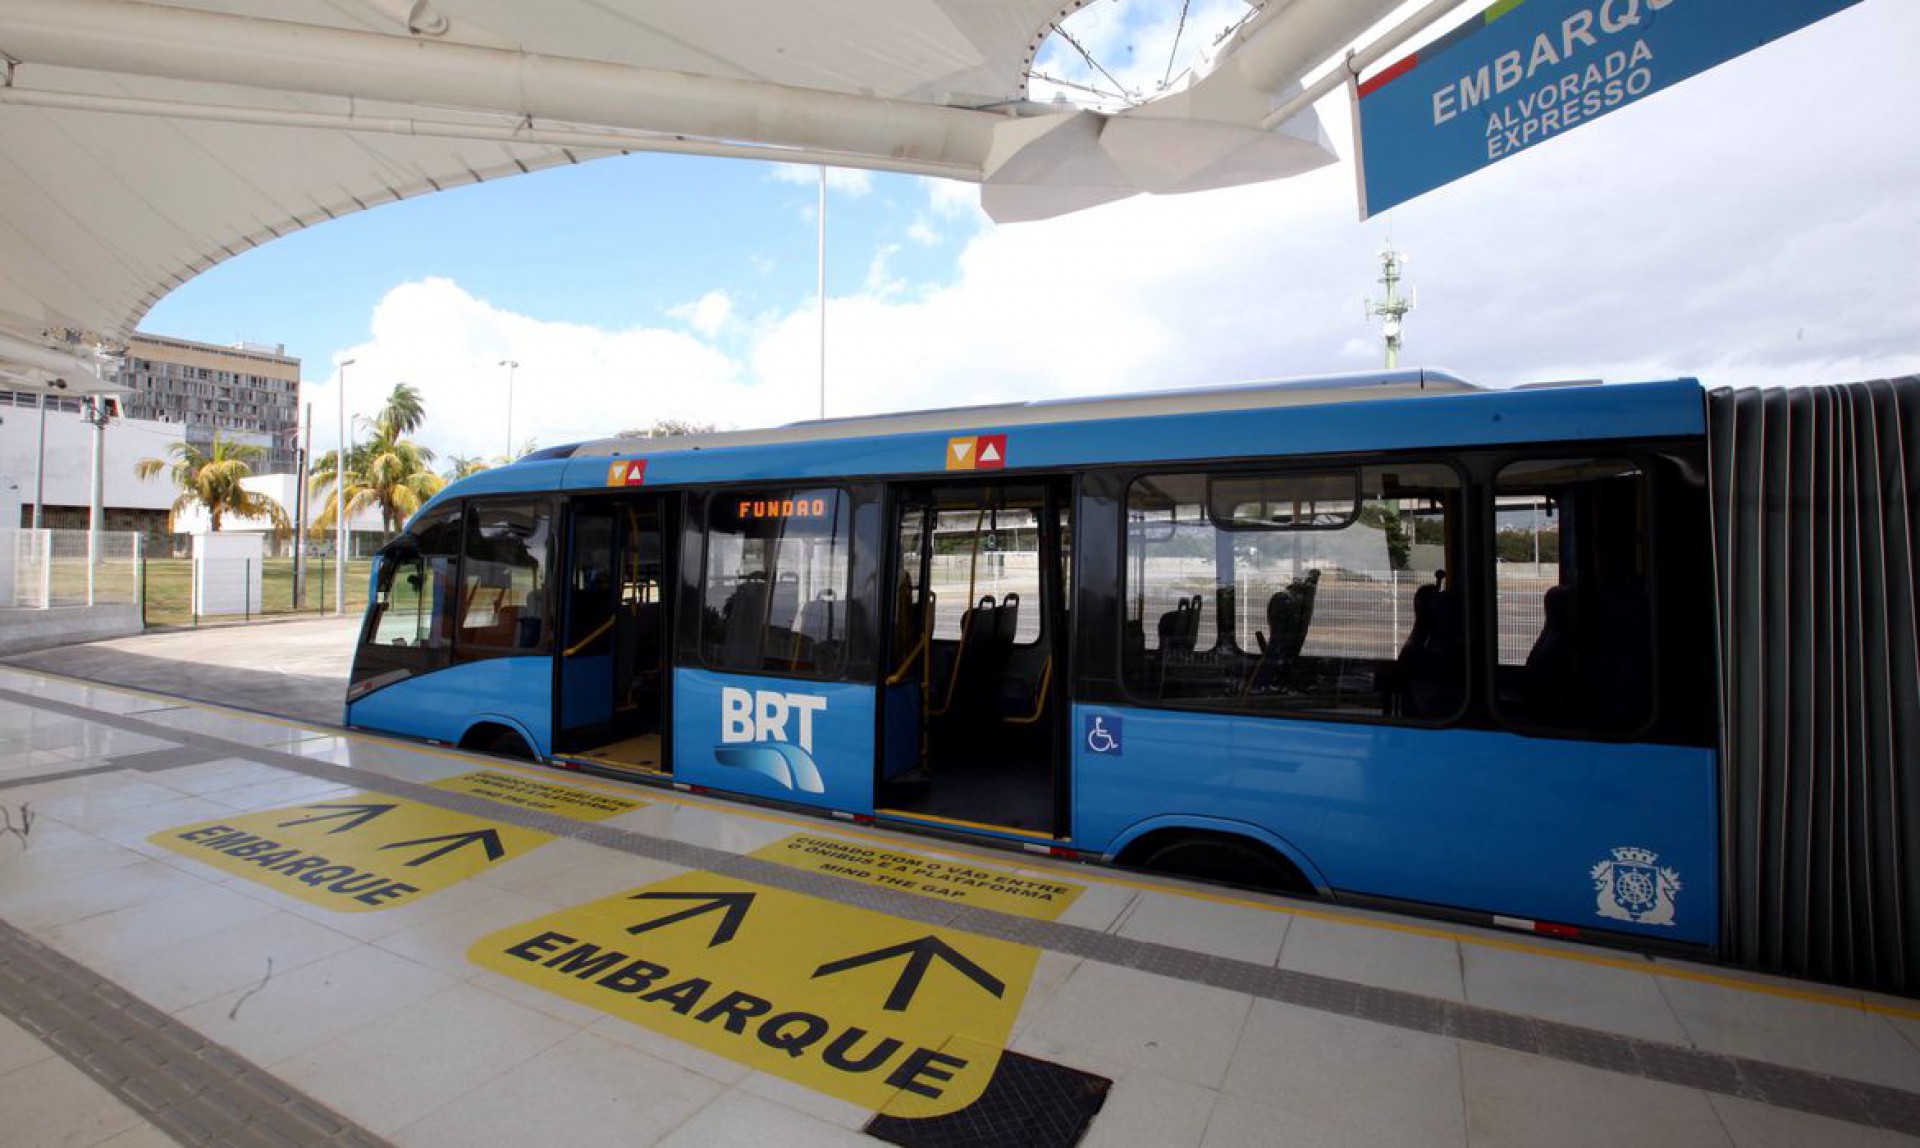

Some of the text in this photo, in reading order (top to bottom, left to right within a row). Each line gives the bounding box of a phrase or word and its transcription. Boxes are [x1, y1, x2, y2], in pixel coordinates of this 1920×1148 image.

[1432, 0, 1677, 126] EMBARQ
[1485, 39, 1653, 137] ALVORADA
[1487, 68, 1651, 159] EXPRESSO
[721, 686, 827, 756] BRT
[178, 825, 421, 906] EMBARQUE
[796, 838, 875, 856] CUIDADO
[880, 854, 923, 866] COM
[995, 876, 1068, 895] ENTRE
[818, 863, 966, 898] MIND THE GAP
[912, 868, 1053, 901] PLATAFORMA
[504, 931, 971, 1099] EMBARQUE
